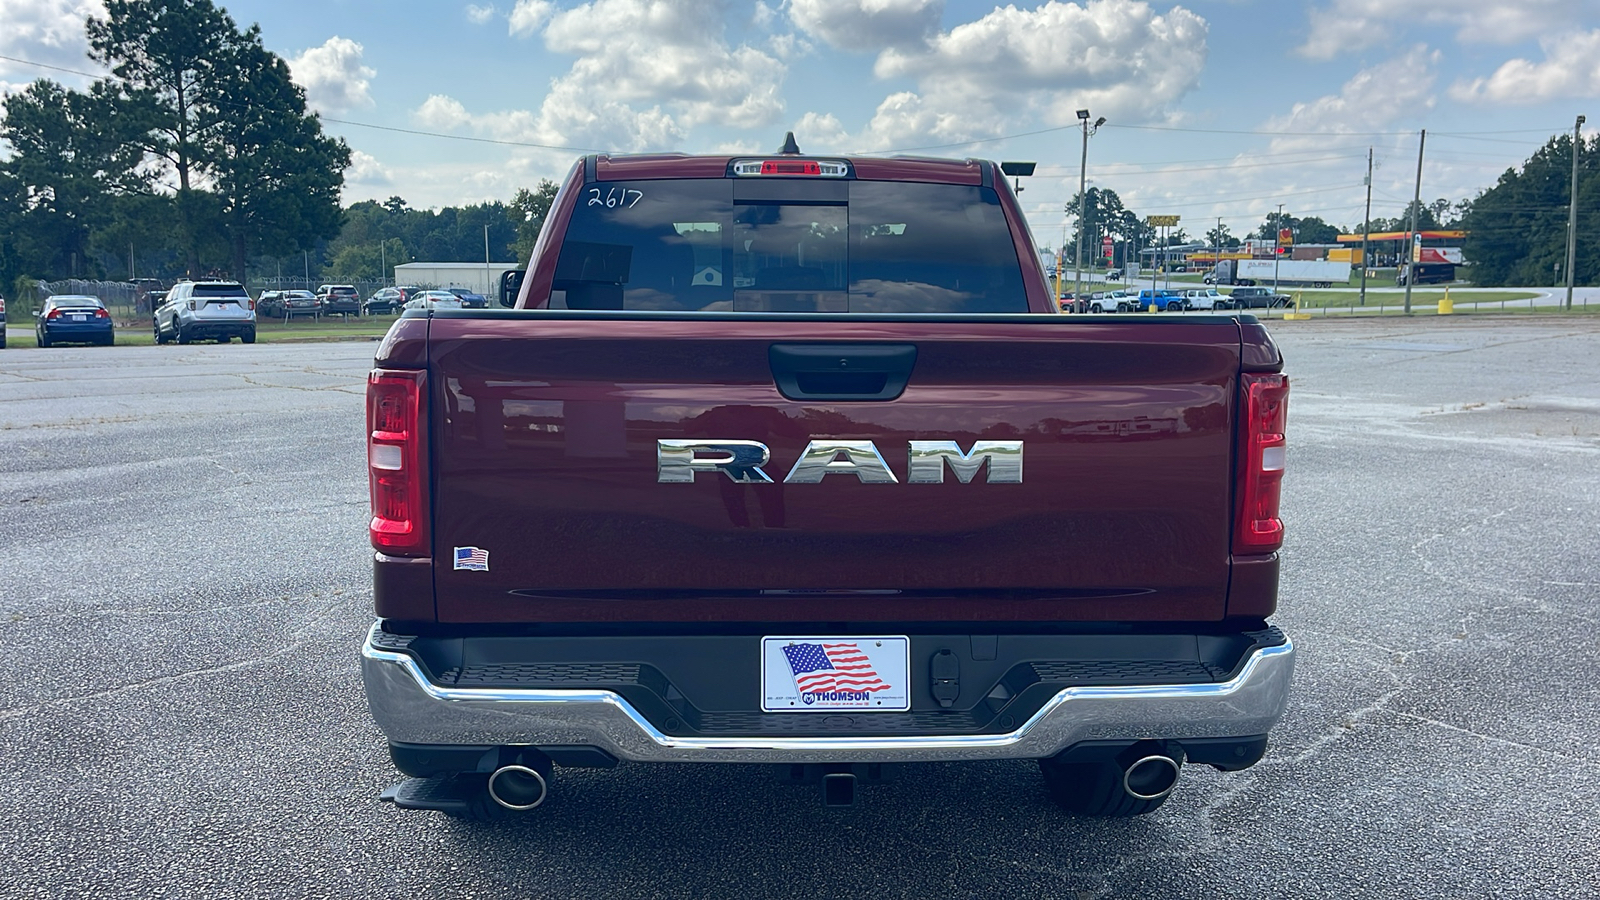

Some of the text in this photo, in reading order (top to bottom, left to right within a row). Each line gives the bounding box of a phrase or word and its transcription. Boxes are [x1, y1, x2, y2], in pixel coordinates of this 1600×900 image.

[588, 187, 643, 209] 2617
[657, 439, 1024, 484] RAM
[816, 692, 870, 701] THOMSON
